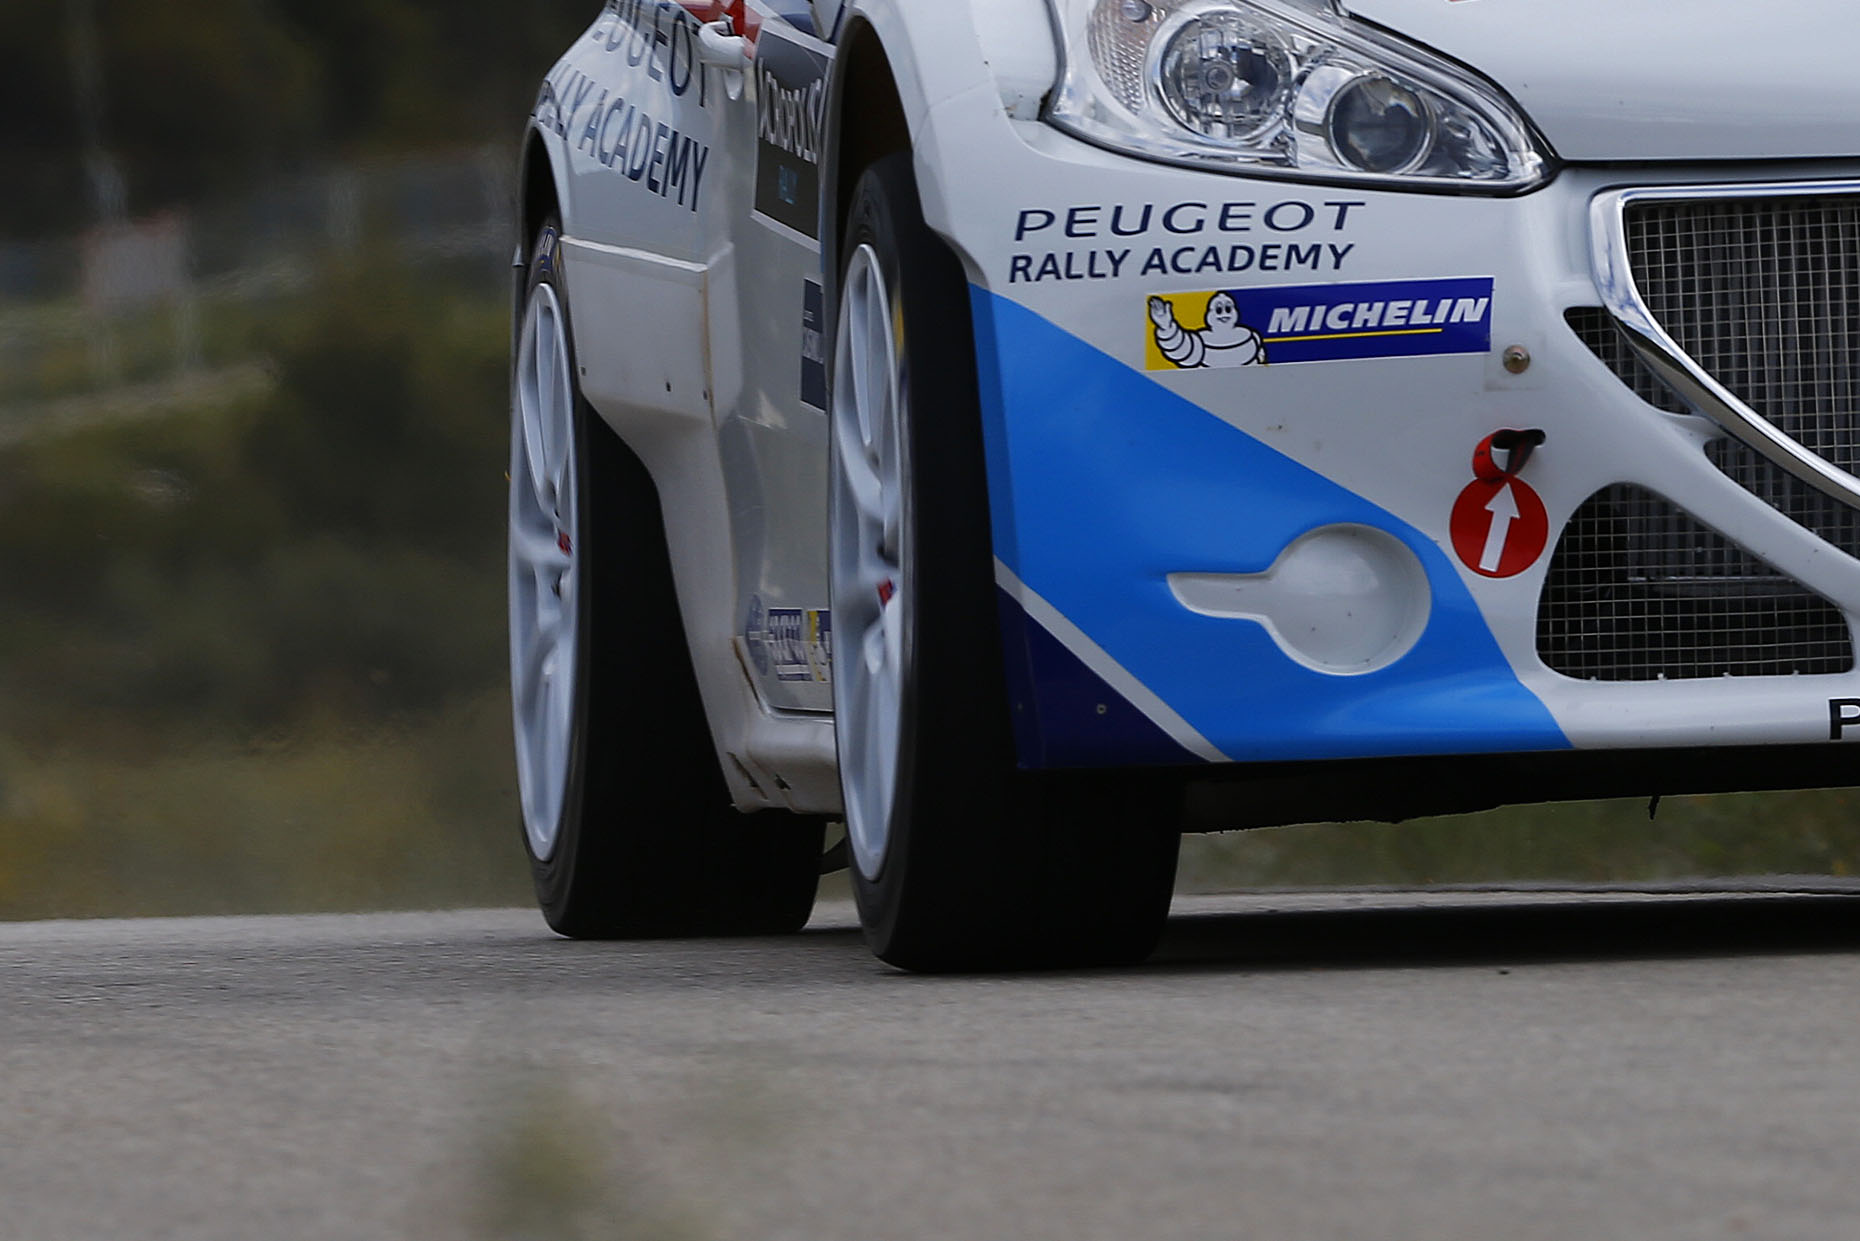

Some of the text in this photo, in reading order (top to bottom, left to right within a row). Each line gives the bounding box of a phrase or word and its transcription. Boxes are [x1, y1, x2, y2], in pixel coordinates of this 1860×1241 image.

[577, 88, 710, 213] ACADEMY
[1013, 201, 1367, 242] PEUGEOT
[1008, 242, 1356, 284] RALLY ACADEMY
[1267, 295, 1489, 334] MICHELIN
